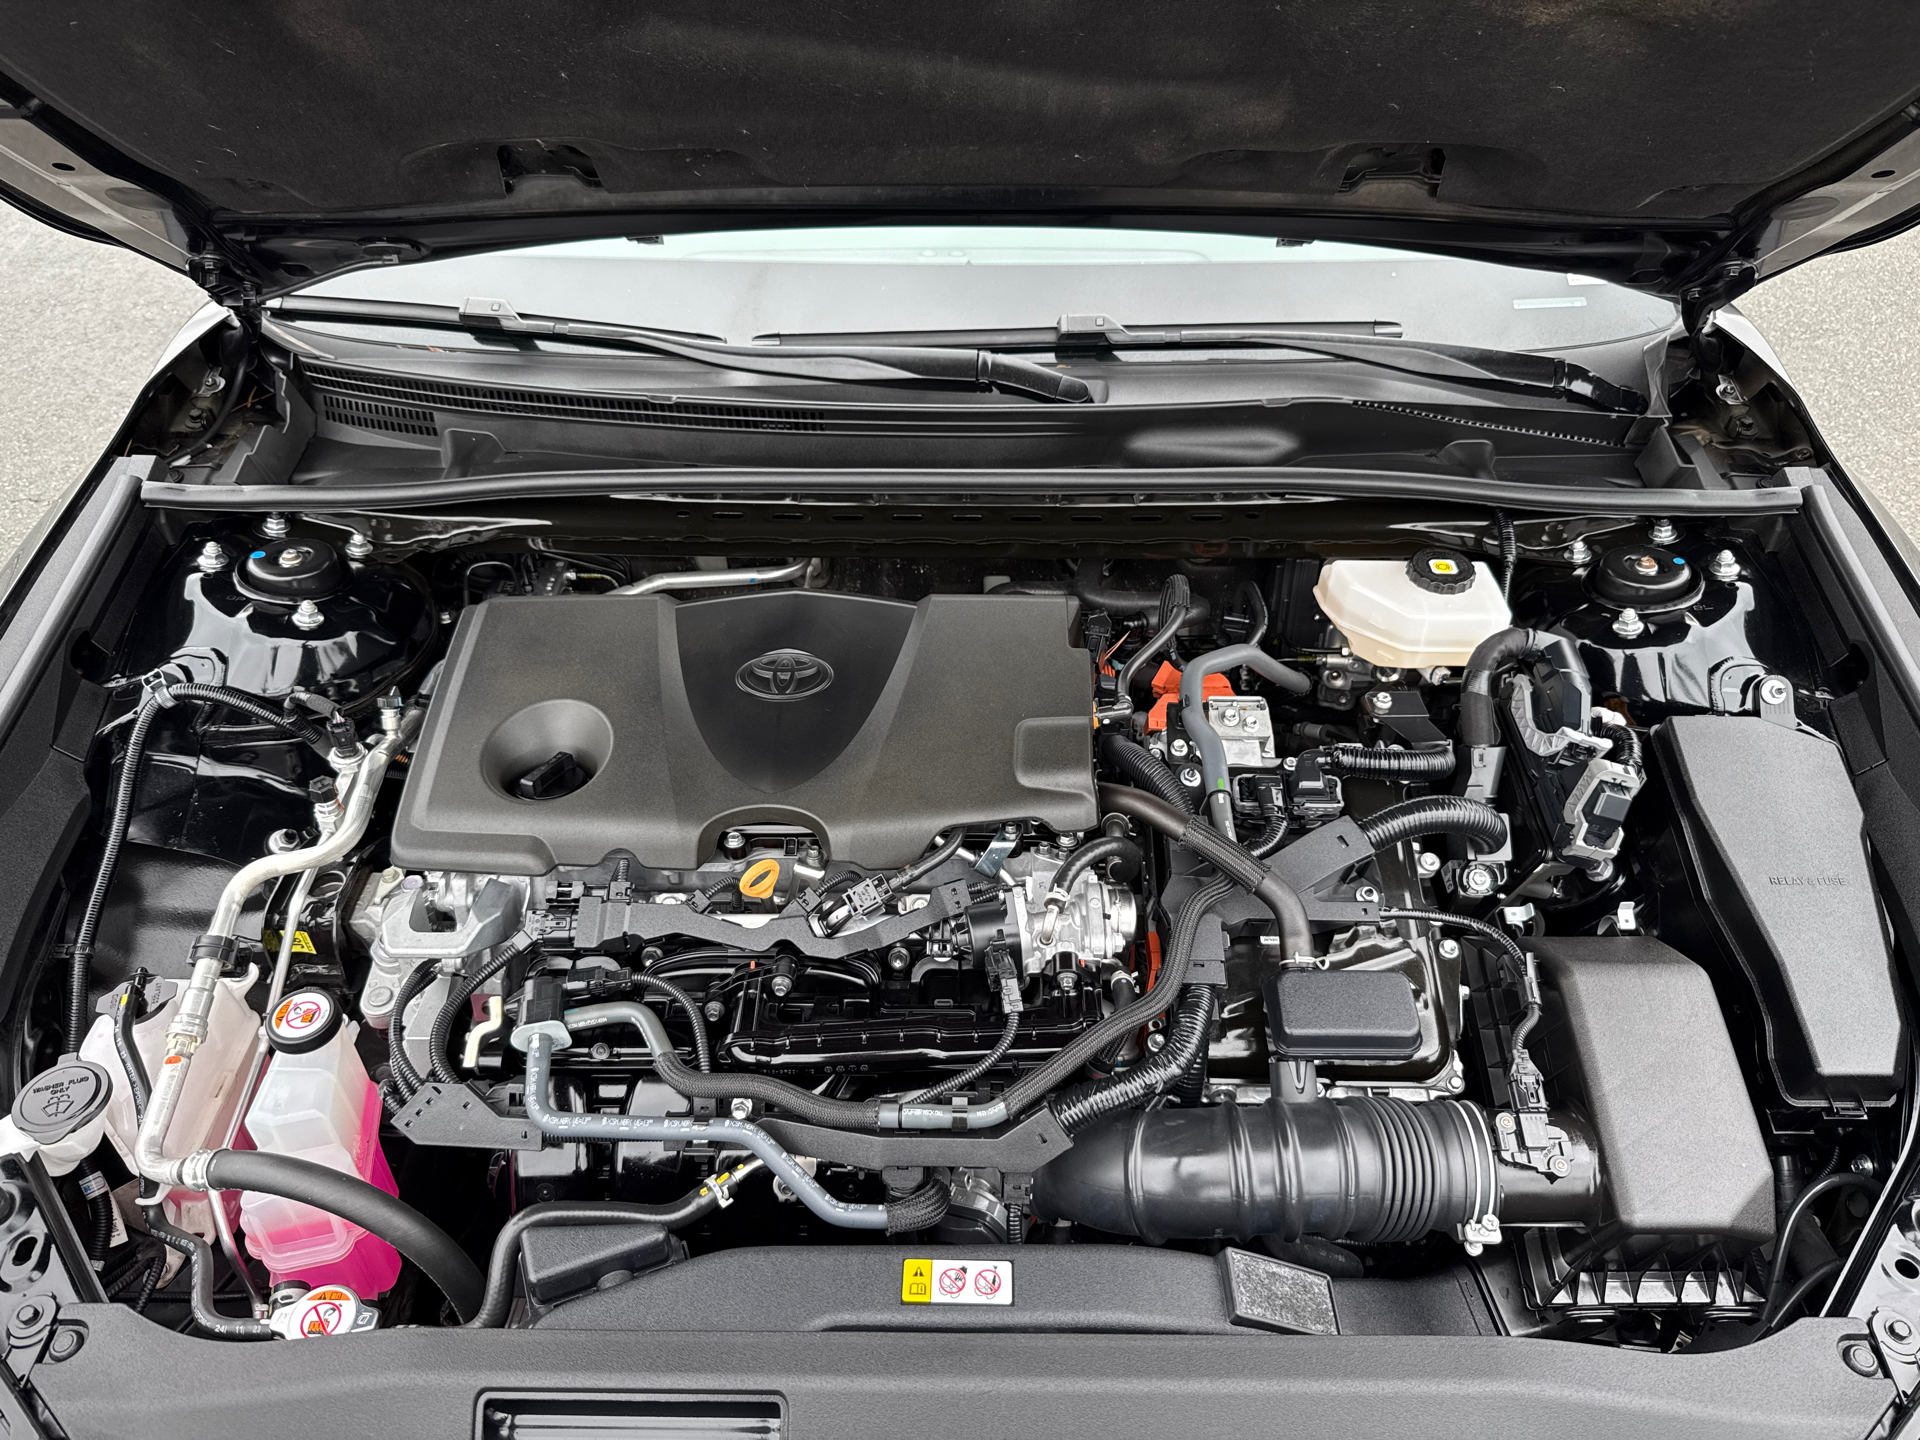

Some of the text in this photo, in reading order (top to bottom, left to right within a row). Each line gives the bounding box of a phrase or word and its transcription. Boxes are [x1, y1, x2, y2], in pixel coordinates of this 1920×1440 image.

[1768, 876, 1847, 886] RELAY & FUSE
[125, 1061, 137, 1083] WATER
[32, 1076, 90, 1095] WASHER FLUID
[50, 1086, 70, 1095] ONLY
